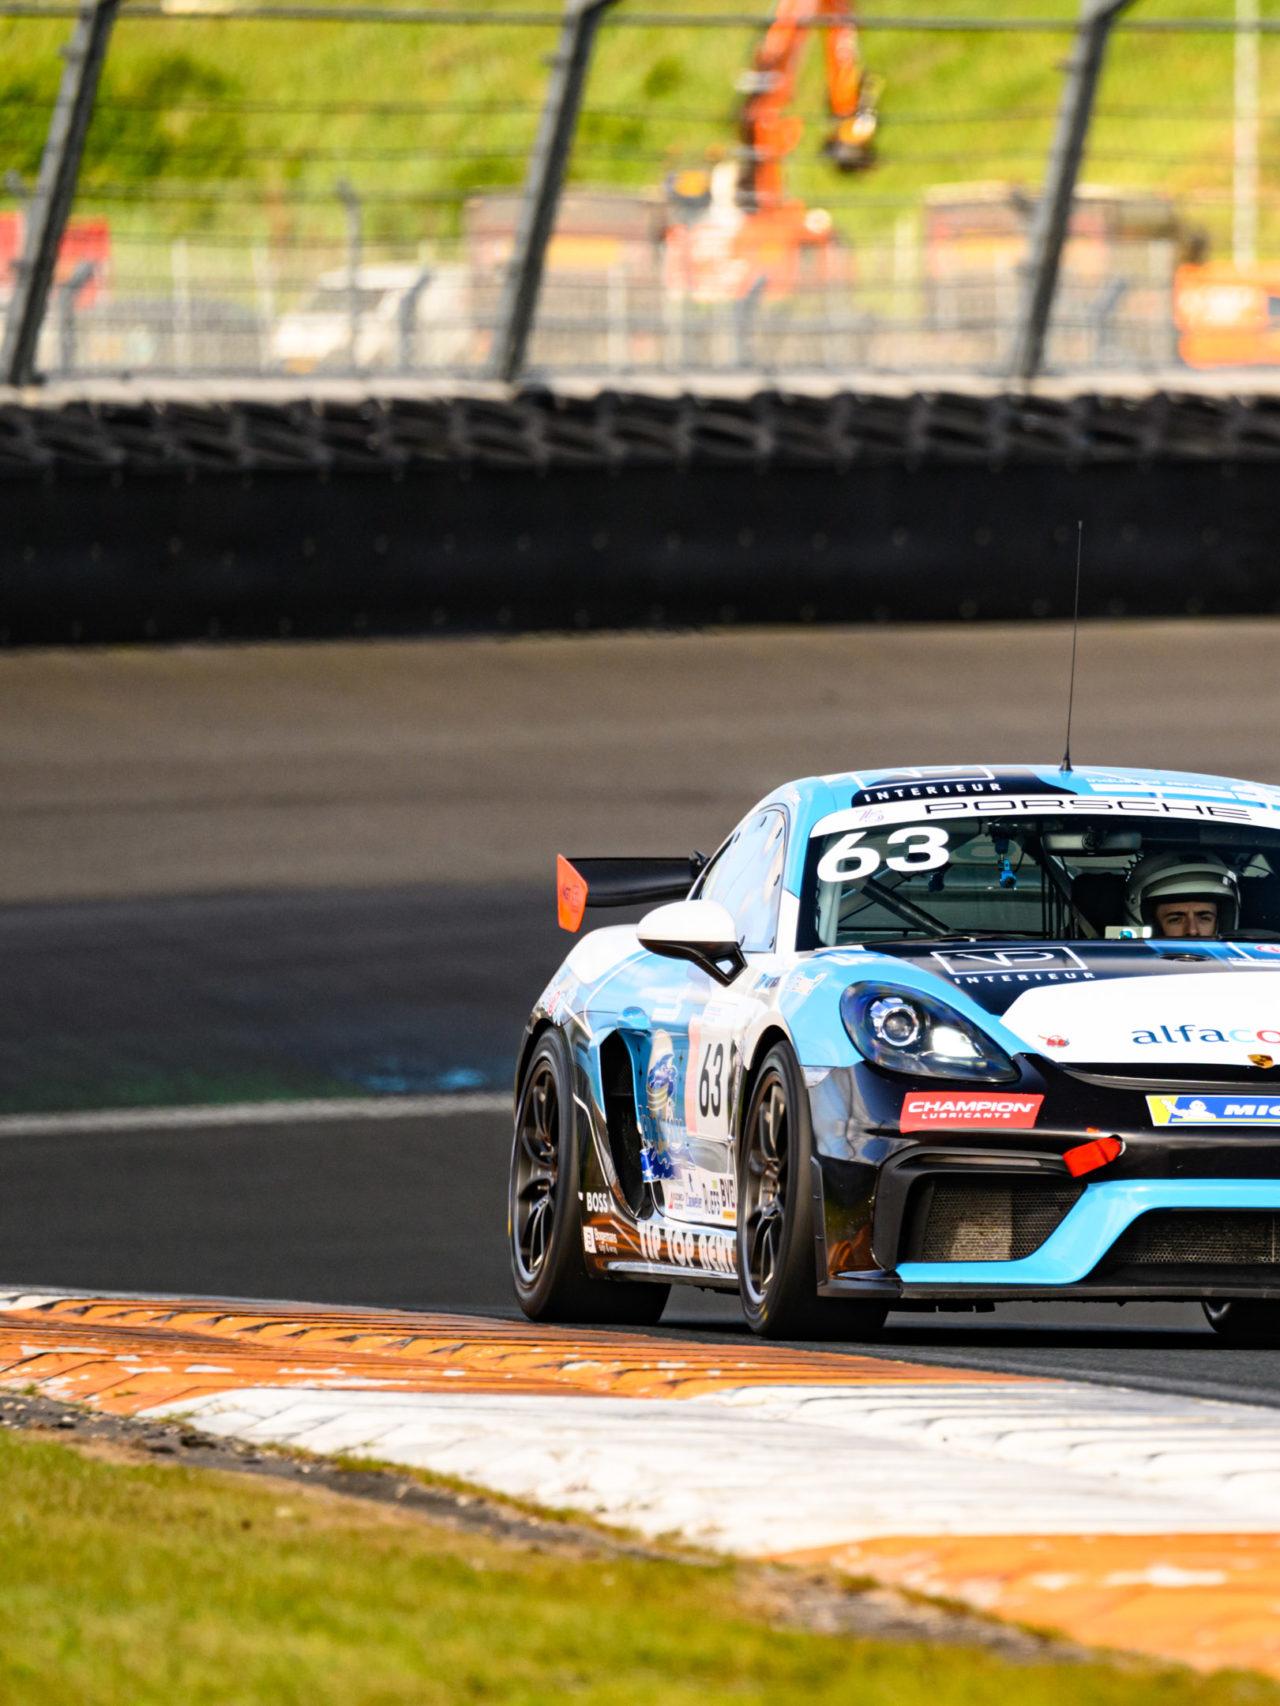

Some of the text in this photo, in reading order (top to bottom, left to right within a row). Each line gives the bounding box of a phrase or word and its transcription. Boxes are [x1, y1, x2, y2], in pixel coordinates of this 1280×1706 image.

[863, 783, 1002, 803] INTERIEUR
[925, 798, 1252, 821] PORSCHE
[816, 826, 950, 883] 63
[953, 972, 1096, 985] INTERIEUR
[699, 1042, 725, 1118] 63
[908, 1101, 1034, 1113] CHAMPION
[921, 1112, 1012, 1120] LUBRICANTS
[586, 1191, 609, 1213] BOSS
[637, 1222, 661, 1261] TIP
[663, 1226, 695, 1268] TOP
